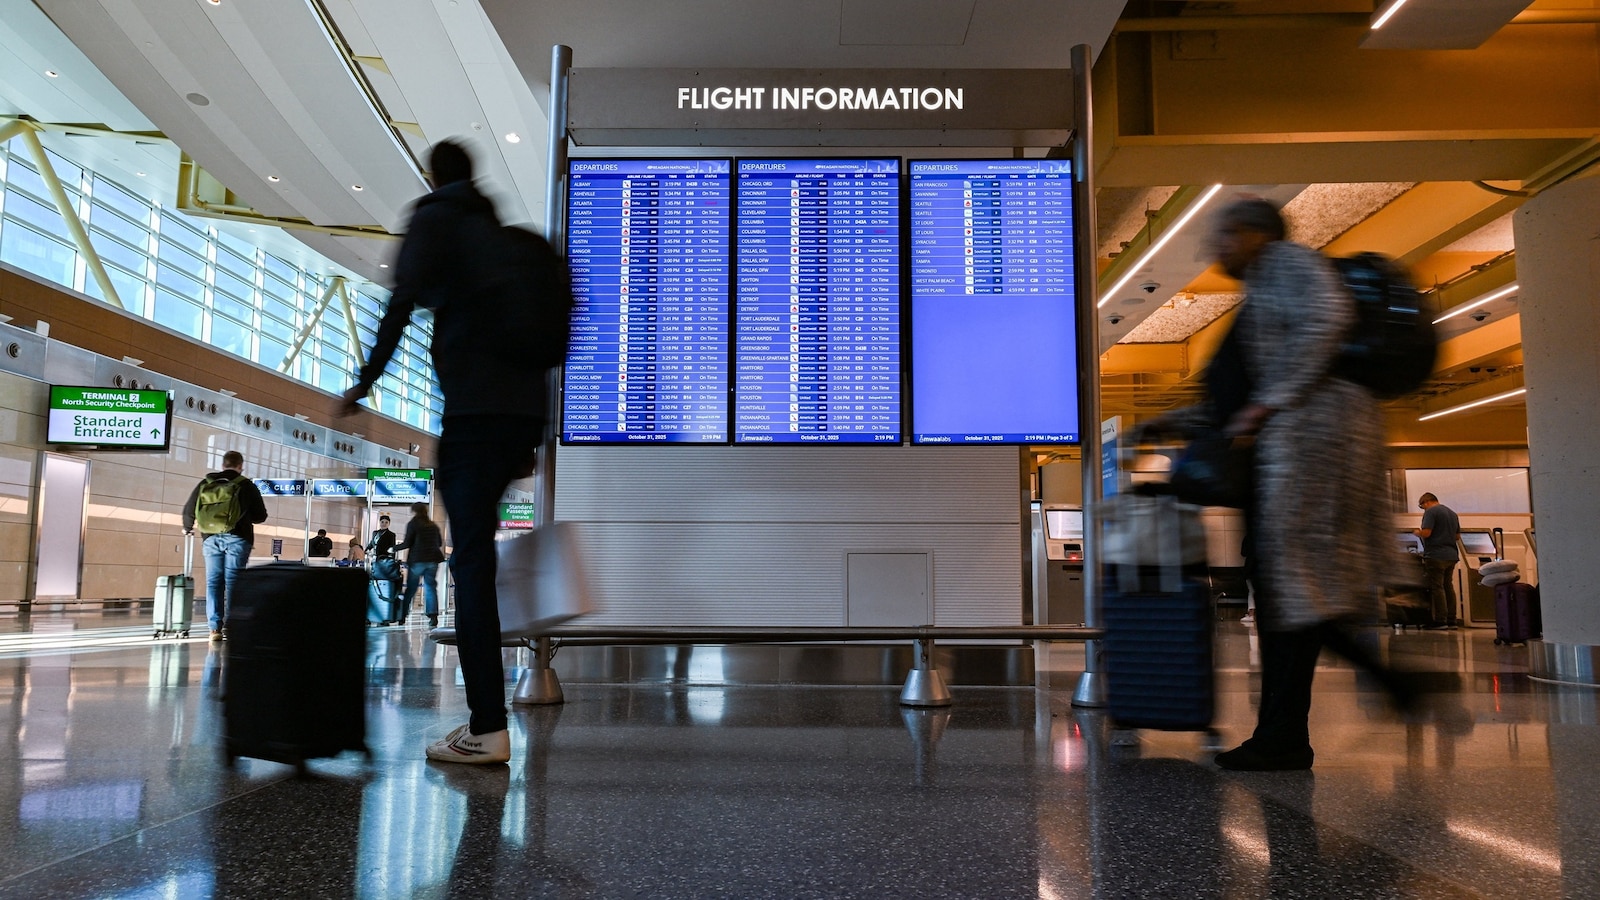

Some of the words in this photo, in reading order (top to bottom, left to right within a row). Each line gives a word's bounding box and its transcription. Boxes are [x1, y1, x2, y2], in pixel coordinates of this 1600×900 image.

[678, 88, 764, 109] FLIGHT
[772, 88, 964, 110] INFORMATION
[82, 392, 127, 400] TERMINAL
[85, 400, 114, 408] Security
[116, 401, 155, 410] Checkpoint
[74, 415, 142, 428] Standard
[74, 426, 141, 438] Entrance
